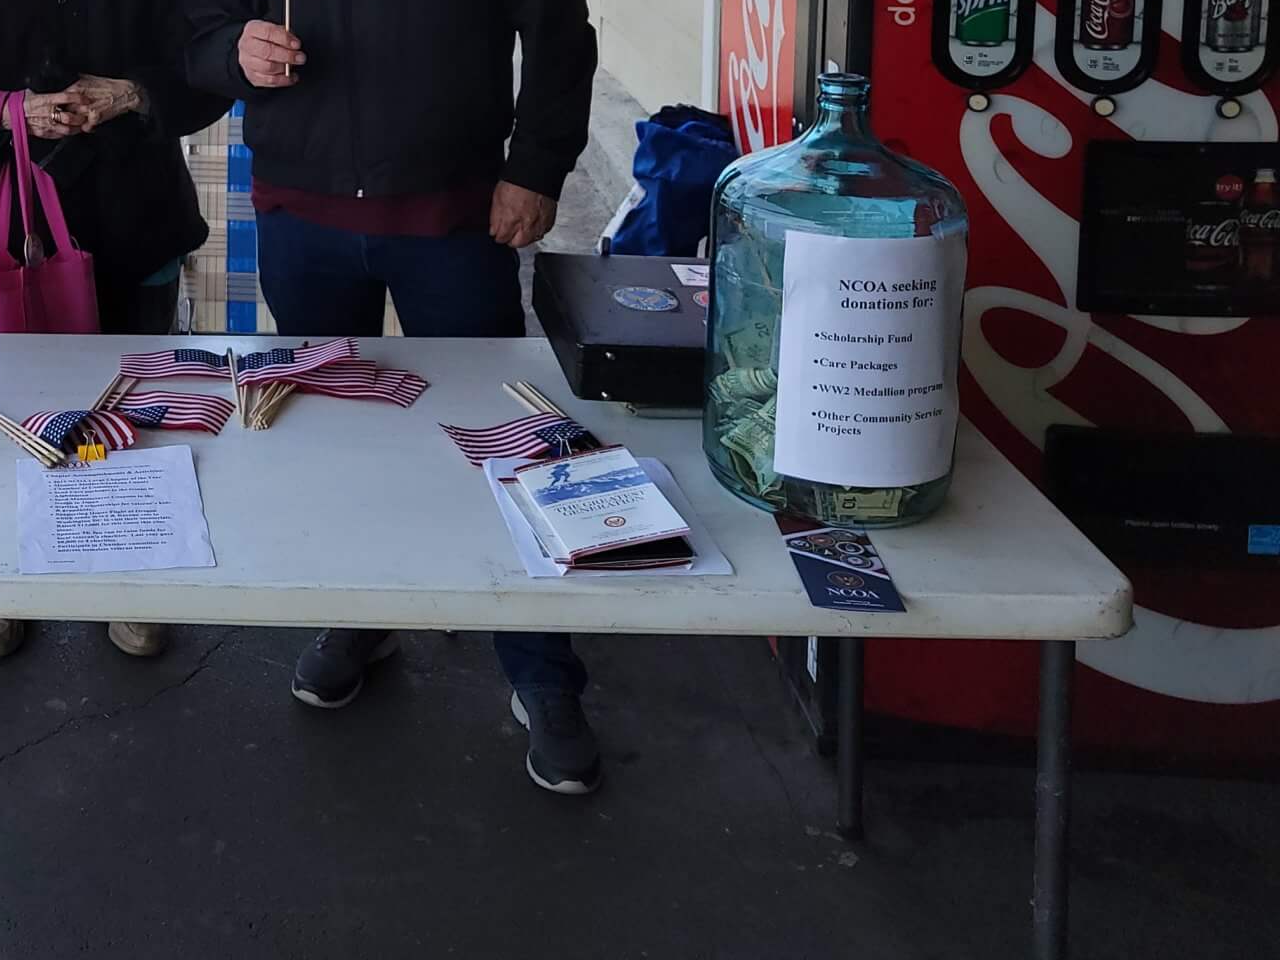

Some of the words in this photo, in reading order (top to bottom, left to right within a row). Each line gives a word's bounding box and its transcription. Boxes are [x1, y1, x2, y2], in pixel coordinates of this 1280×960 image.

[839, 279, 888, 292] NCOA
[892, 279, 937, 292] seeking
[841, 297, 909, 310] donations
[912, 296, 934, 308] for:
[820, 331, 885, 346] Scholarship
[888, 333, 913, 344] Fund
[820, 358, 847, 370] Care
[850, 360, 898, 372] Packages
[819, 383, 850, 395] WW2
[854, 387, 905, 397] Medallion
[908, 382, 943, 398] program
[818, 410, 851, 422] Other
[853, 412, 912, 424] Community
[817, 423, 862, 436] Projects
